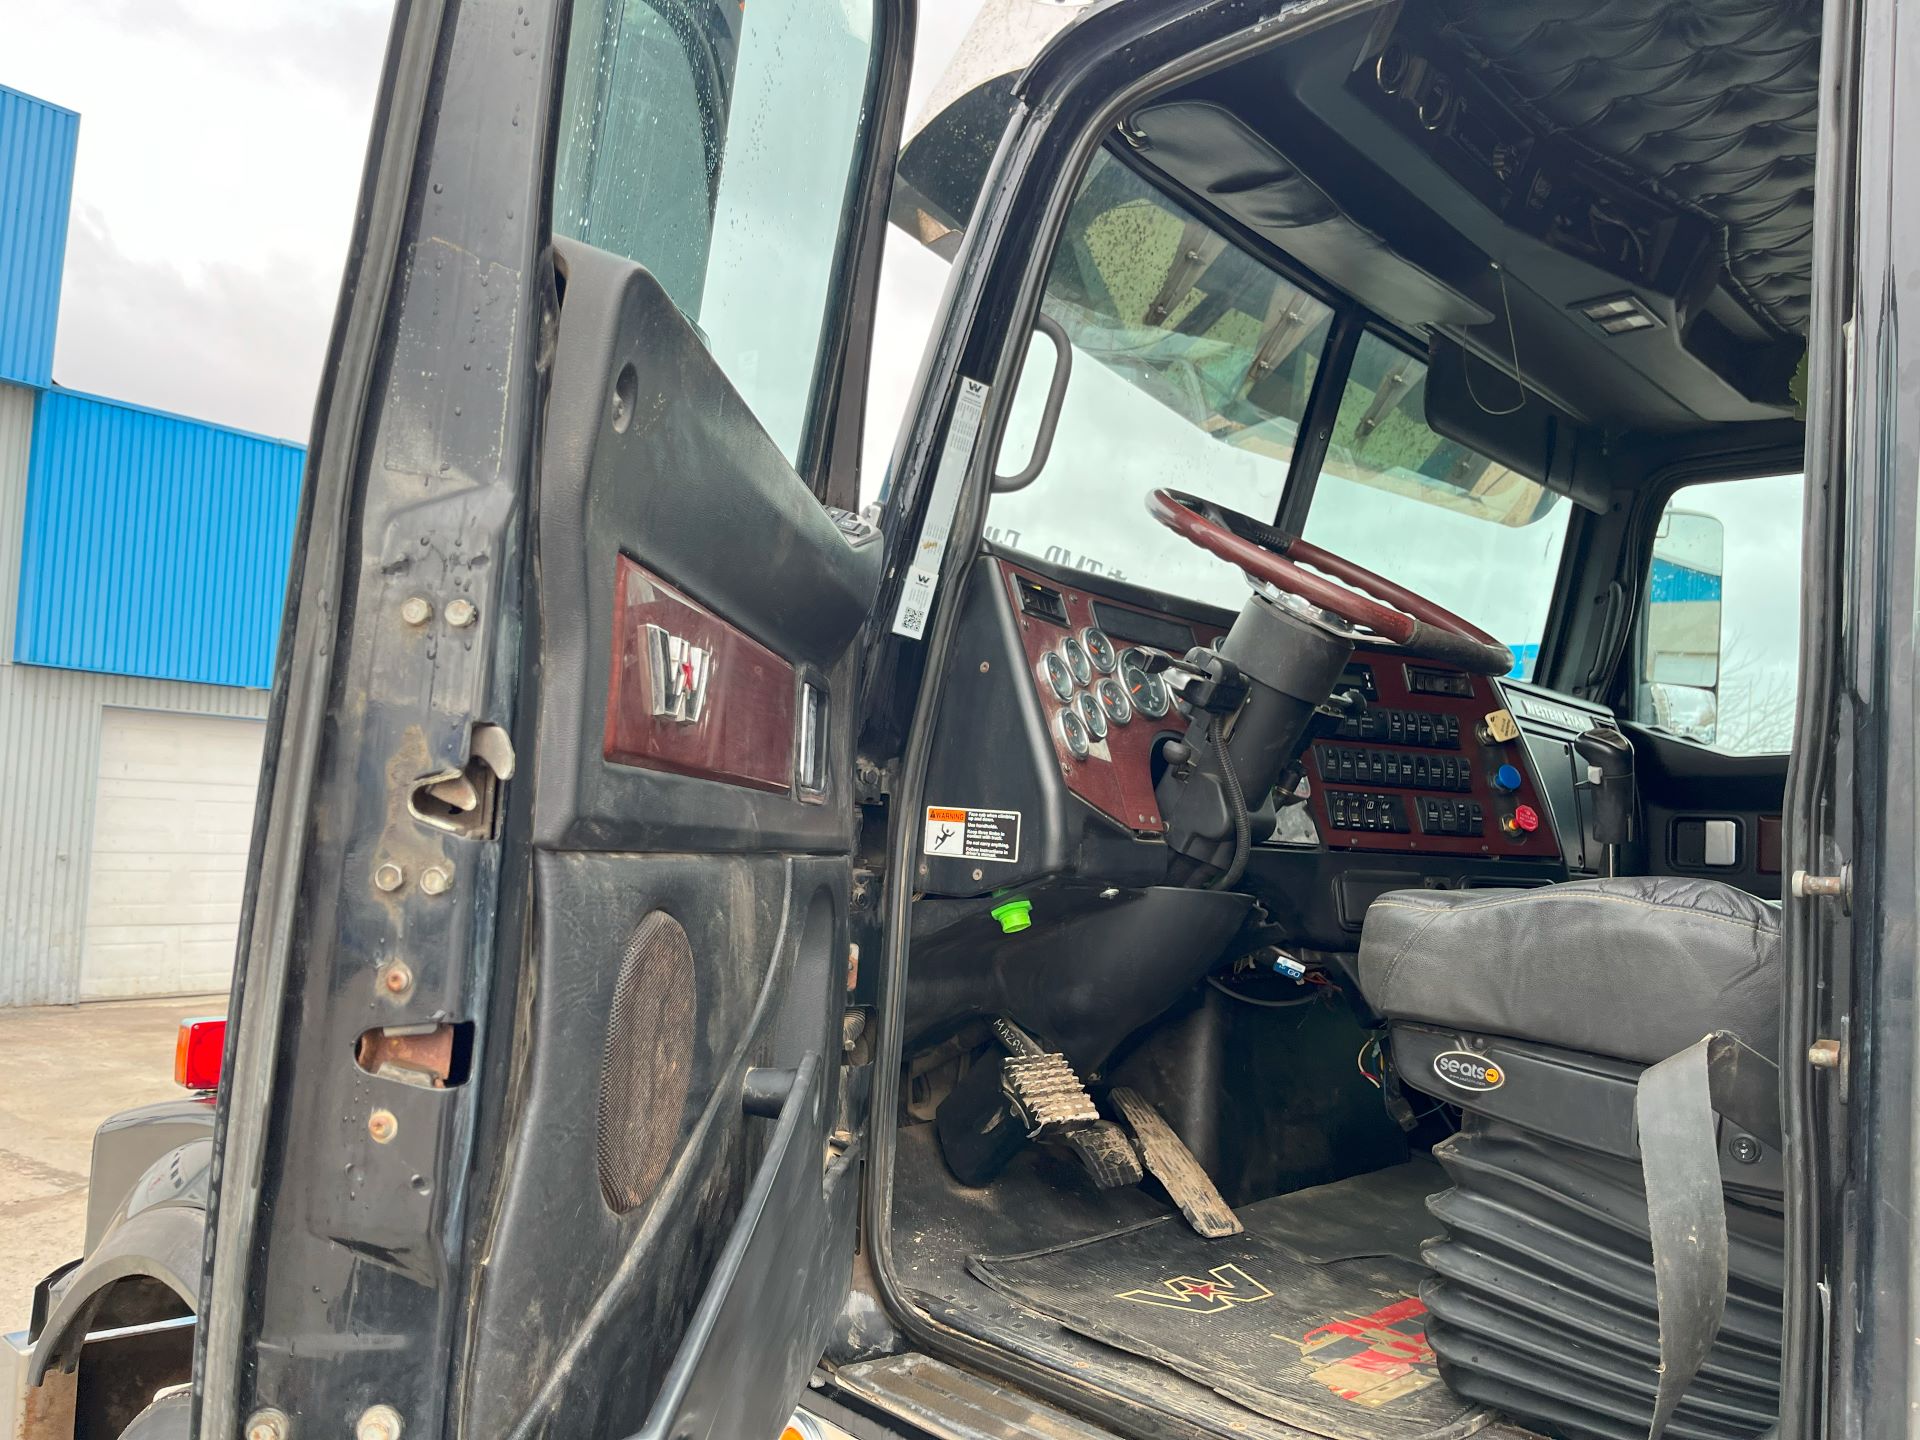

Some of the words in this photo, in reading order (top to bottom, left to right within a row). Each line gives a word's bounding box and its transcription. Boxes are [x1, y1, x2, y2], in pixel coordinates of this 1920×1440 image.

[1522, 700, 1567, 724] WESTERN
[936, 812, 964, 821] WARNING
[1440, 1057, 1486, 1080] seats
